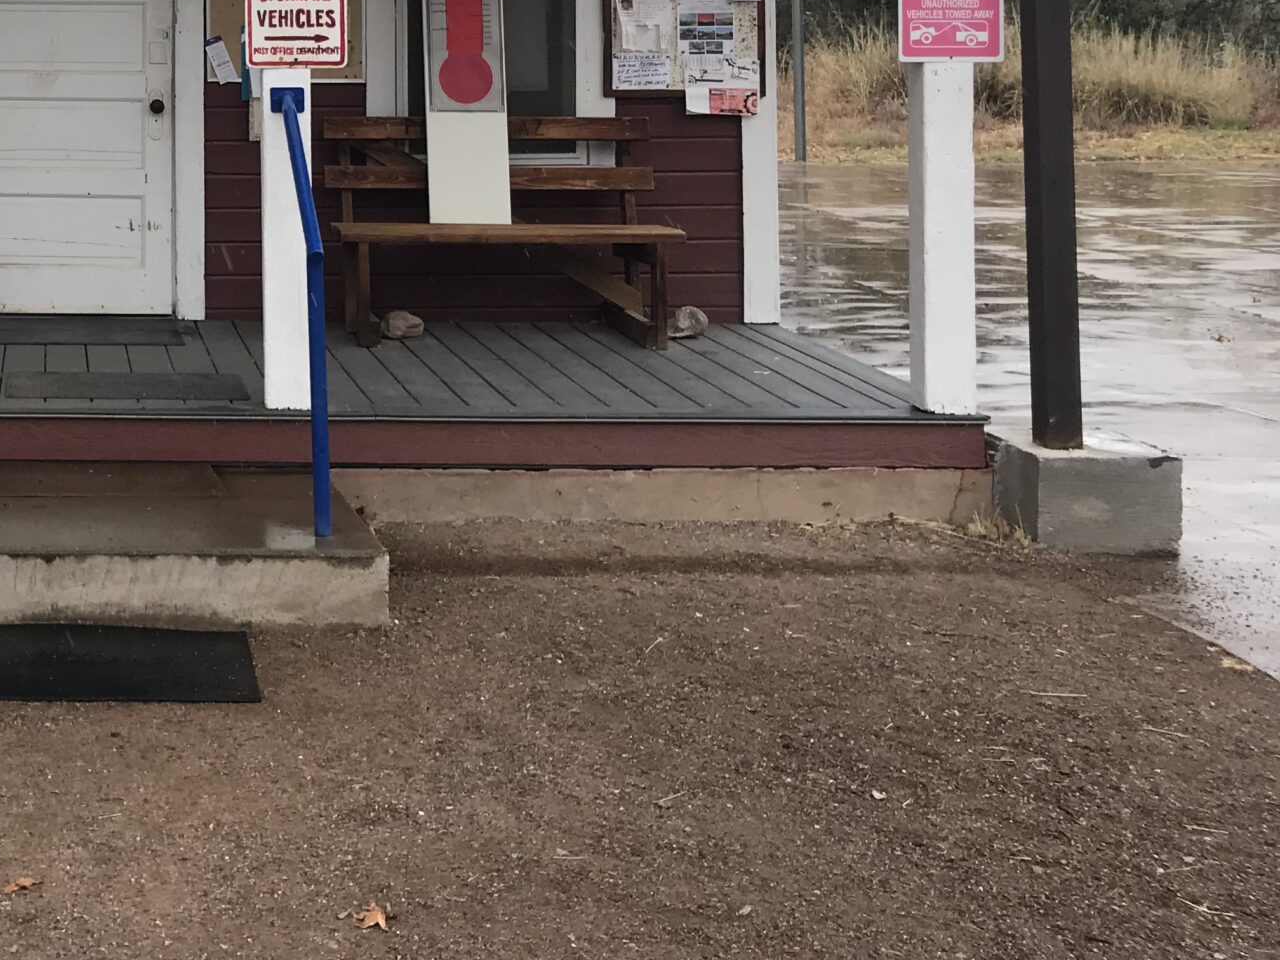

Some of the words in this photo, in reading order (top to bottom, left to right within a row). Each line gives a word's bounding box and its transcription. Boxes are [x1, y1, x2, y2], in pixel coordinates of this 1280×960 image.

[921, 0, 979, 8] UNAUTHORIZED
[256, 8, 336, 29] VEHICLES
[906, 9, 944, 19] VEHICLES
[945, 9, 972, 19] TOWED
[973, 9, 995, 19] AWAY
[270, 46, 294, 55] OFFICE
